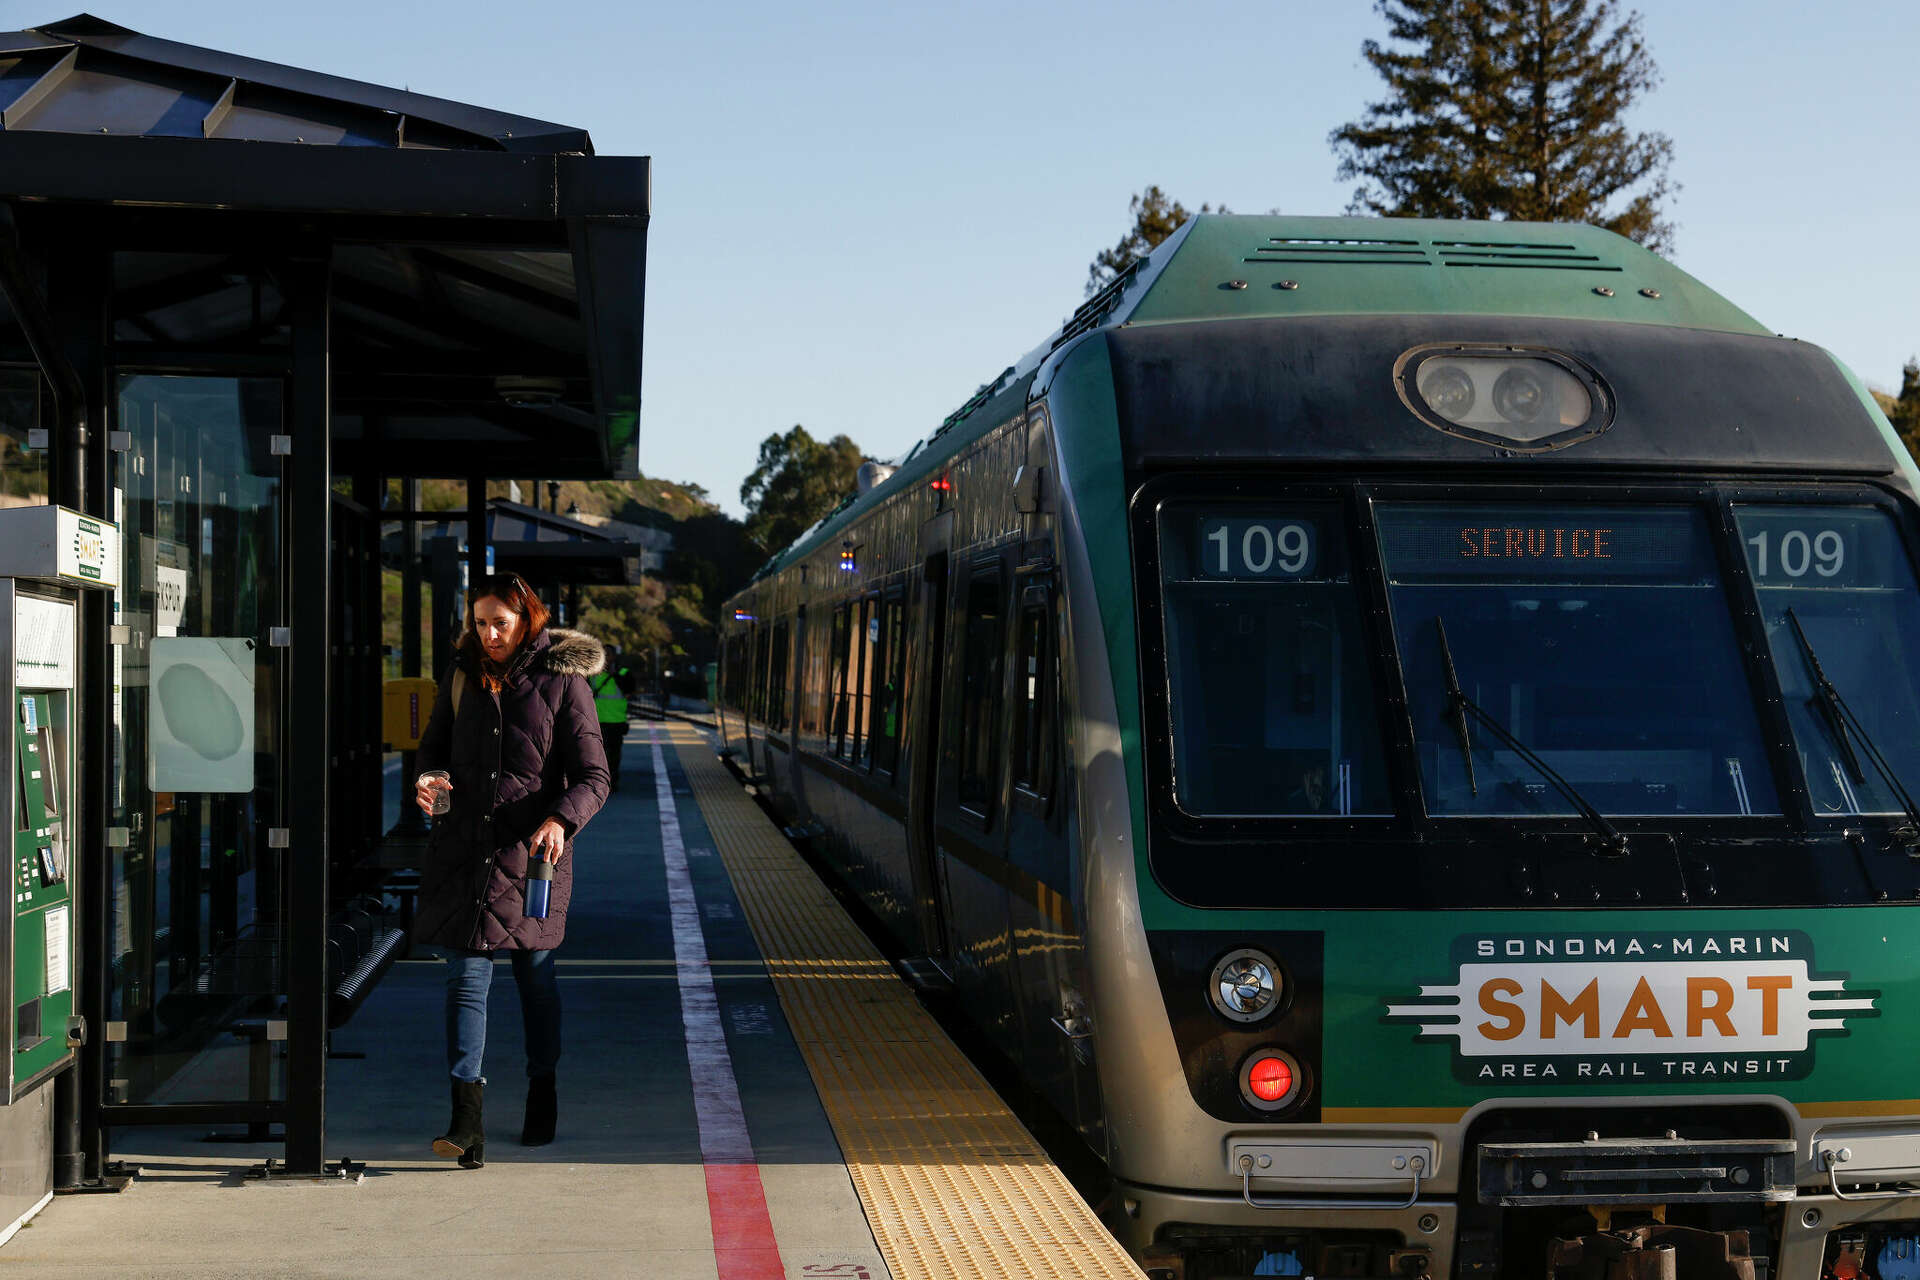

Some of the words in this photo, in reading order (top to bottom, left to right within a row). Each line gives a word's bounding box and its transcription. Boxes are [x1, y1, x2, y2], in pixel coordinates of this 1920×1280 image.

[1207, 525, 1309, 573] 109
[1460, 528, 1613, 558] SERVICE
[1747, 530, 1844, 577] 109
[1477, 975, 1793, 1041] SMART
[1479, 1063, 1558, 1078] AREA
[1578, 1062, 1645, 1077] RAIL
[1663, 1059, 1790, 1075] TRANSIT
